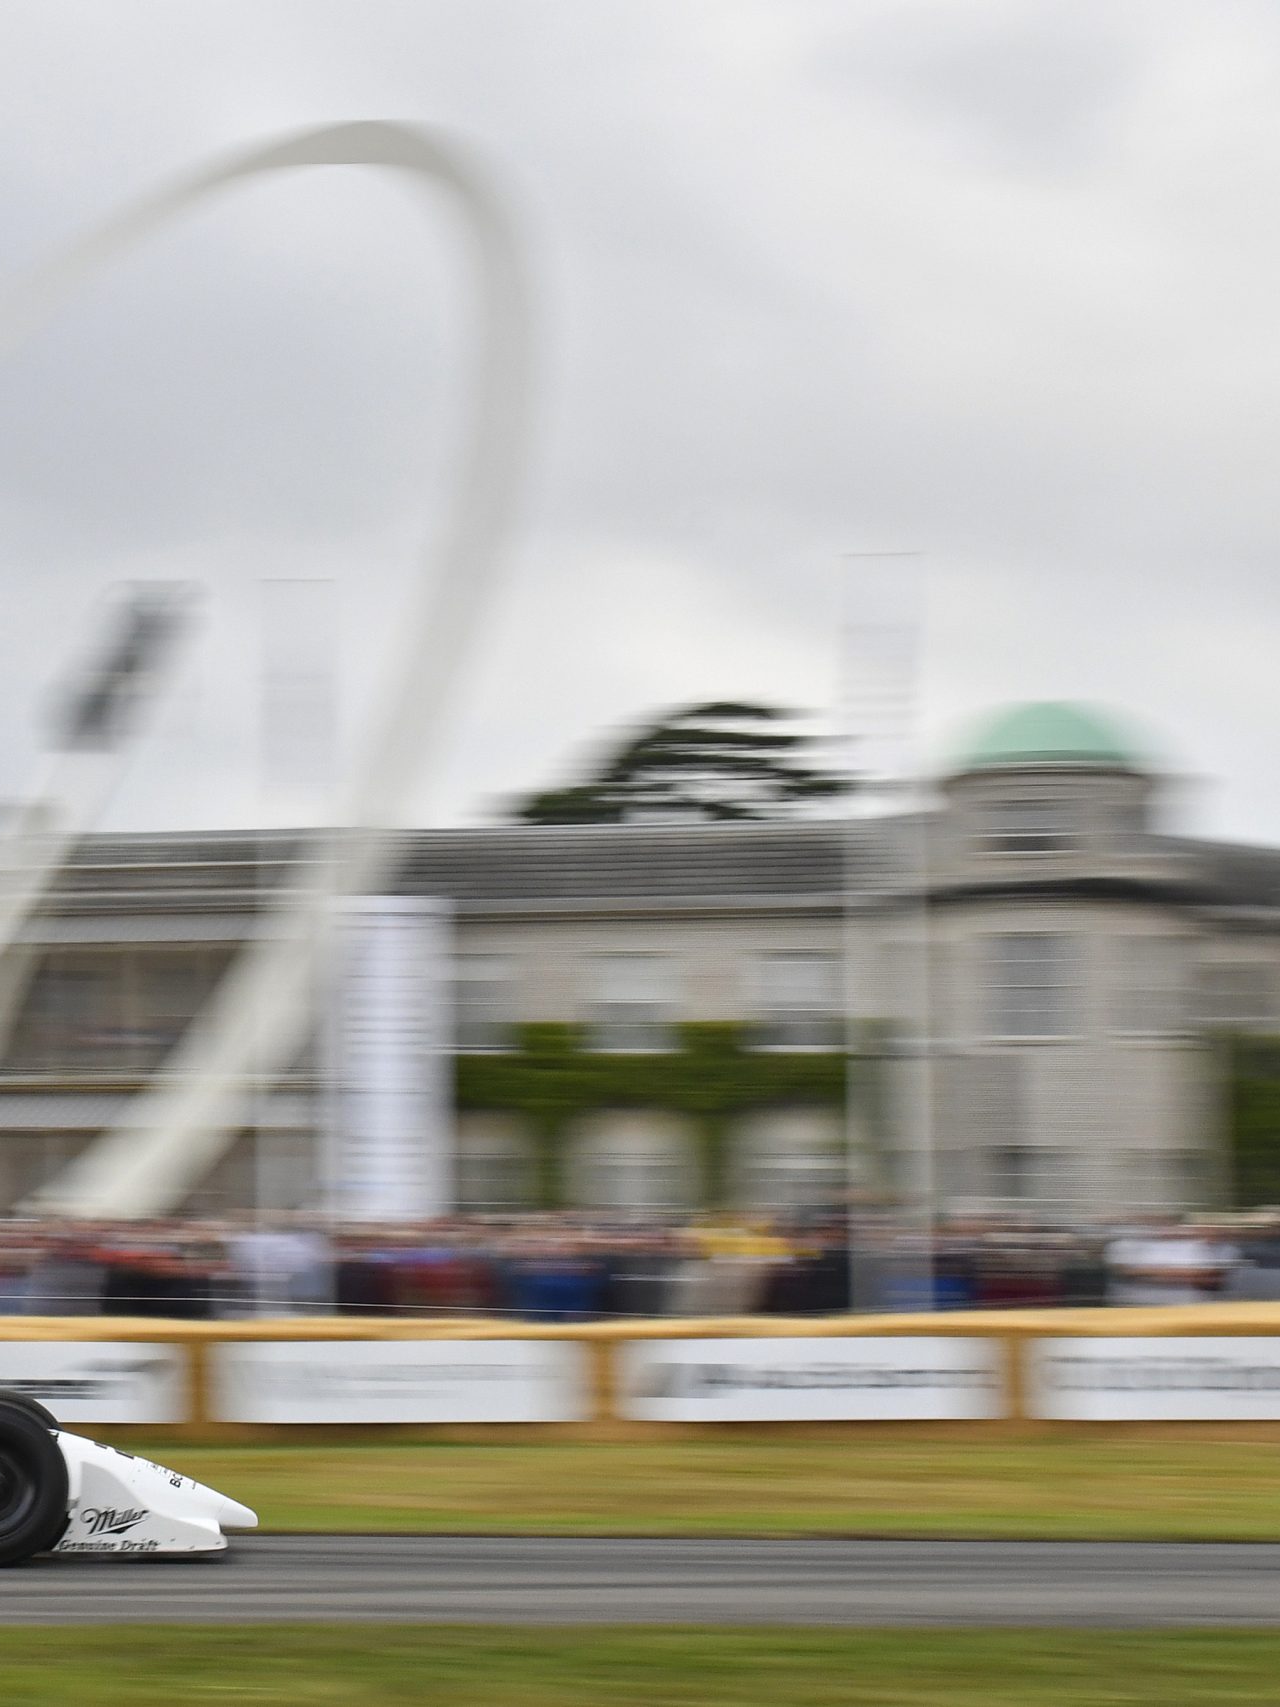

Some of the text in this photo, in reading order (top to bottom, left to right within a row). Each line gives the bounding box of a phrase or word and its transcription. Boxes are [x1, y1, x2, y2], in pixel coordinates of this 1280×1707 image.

[81, 1507, 149, 1534] Miller
[60, 1538, 161, 1550] Genuine Draft
